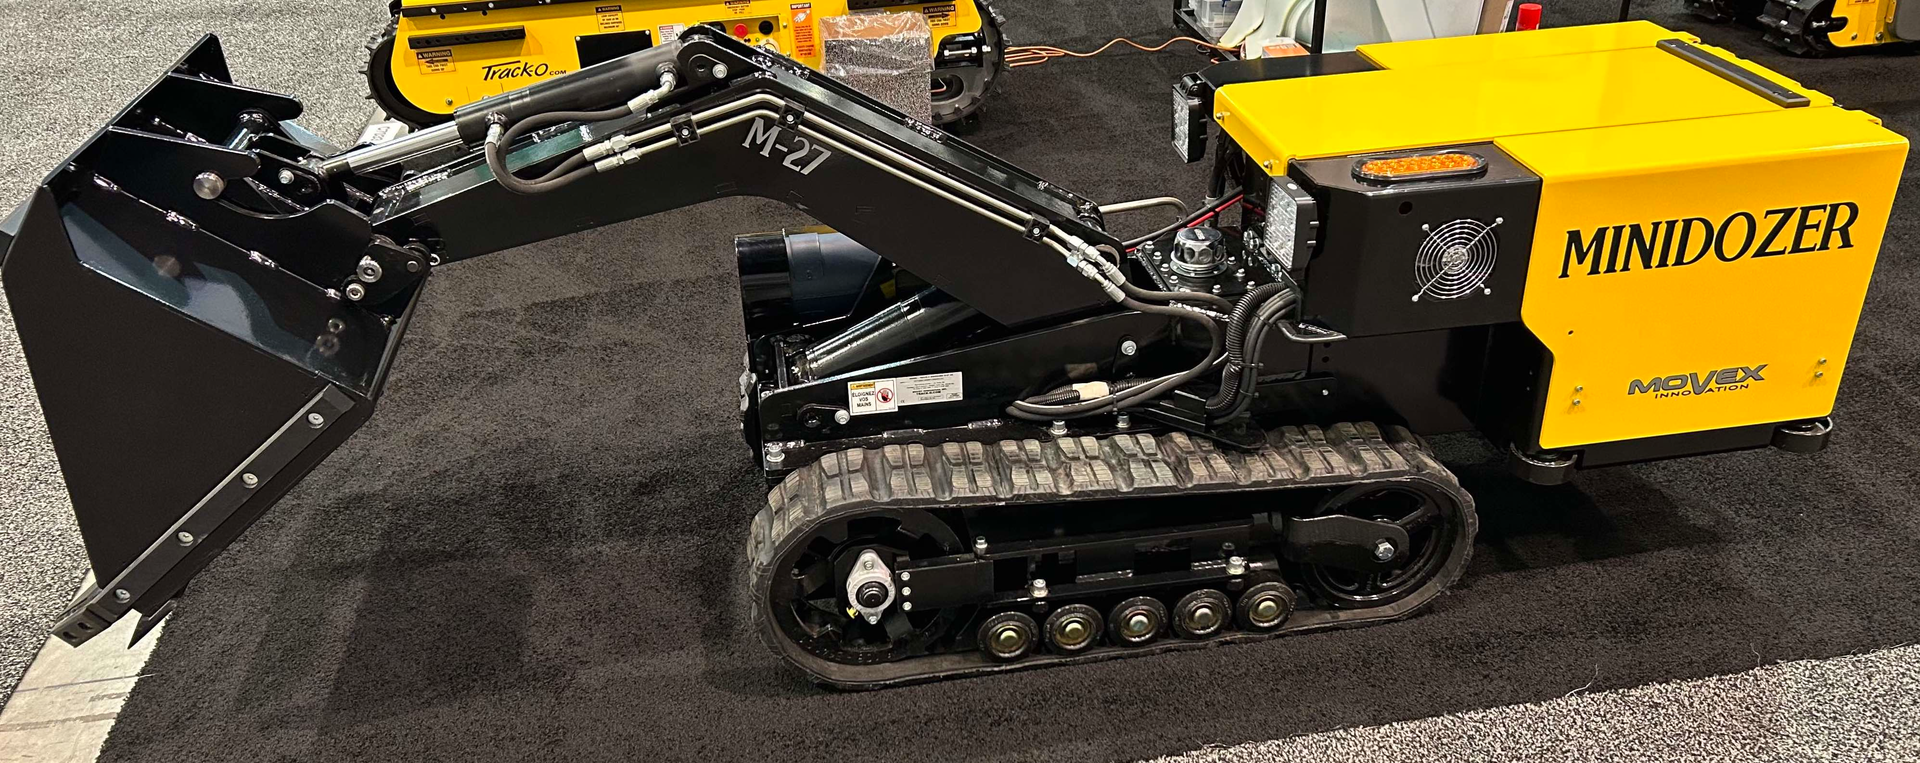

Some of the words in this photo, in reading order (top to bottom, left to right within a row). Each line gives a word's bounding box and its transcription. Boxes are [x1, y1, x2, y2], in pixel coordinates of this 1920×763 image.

[422, 50, 451, 58] WARNING
[742, 117, 832, 175] M-27
[1558, 201, 1859, 278] MINIDOZER
[1627, 364, 1768, 395] MOVEX
